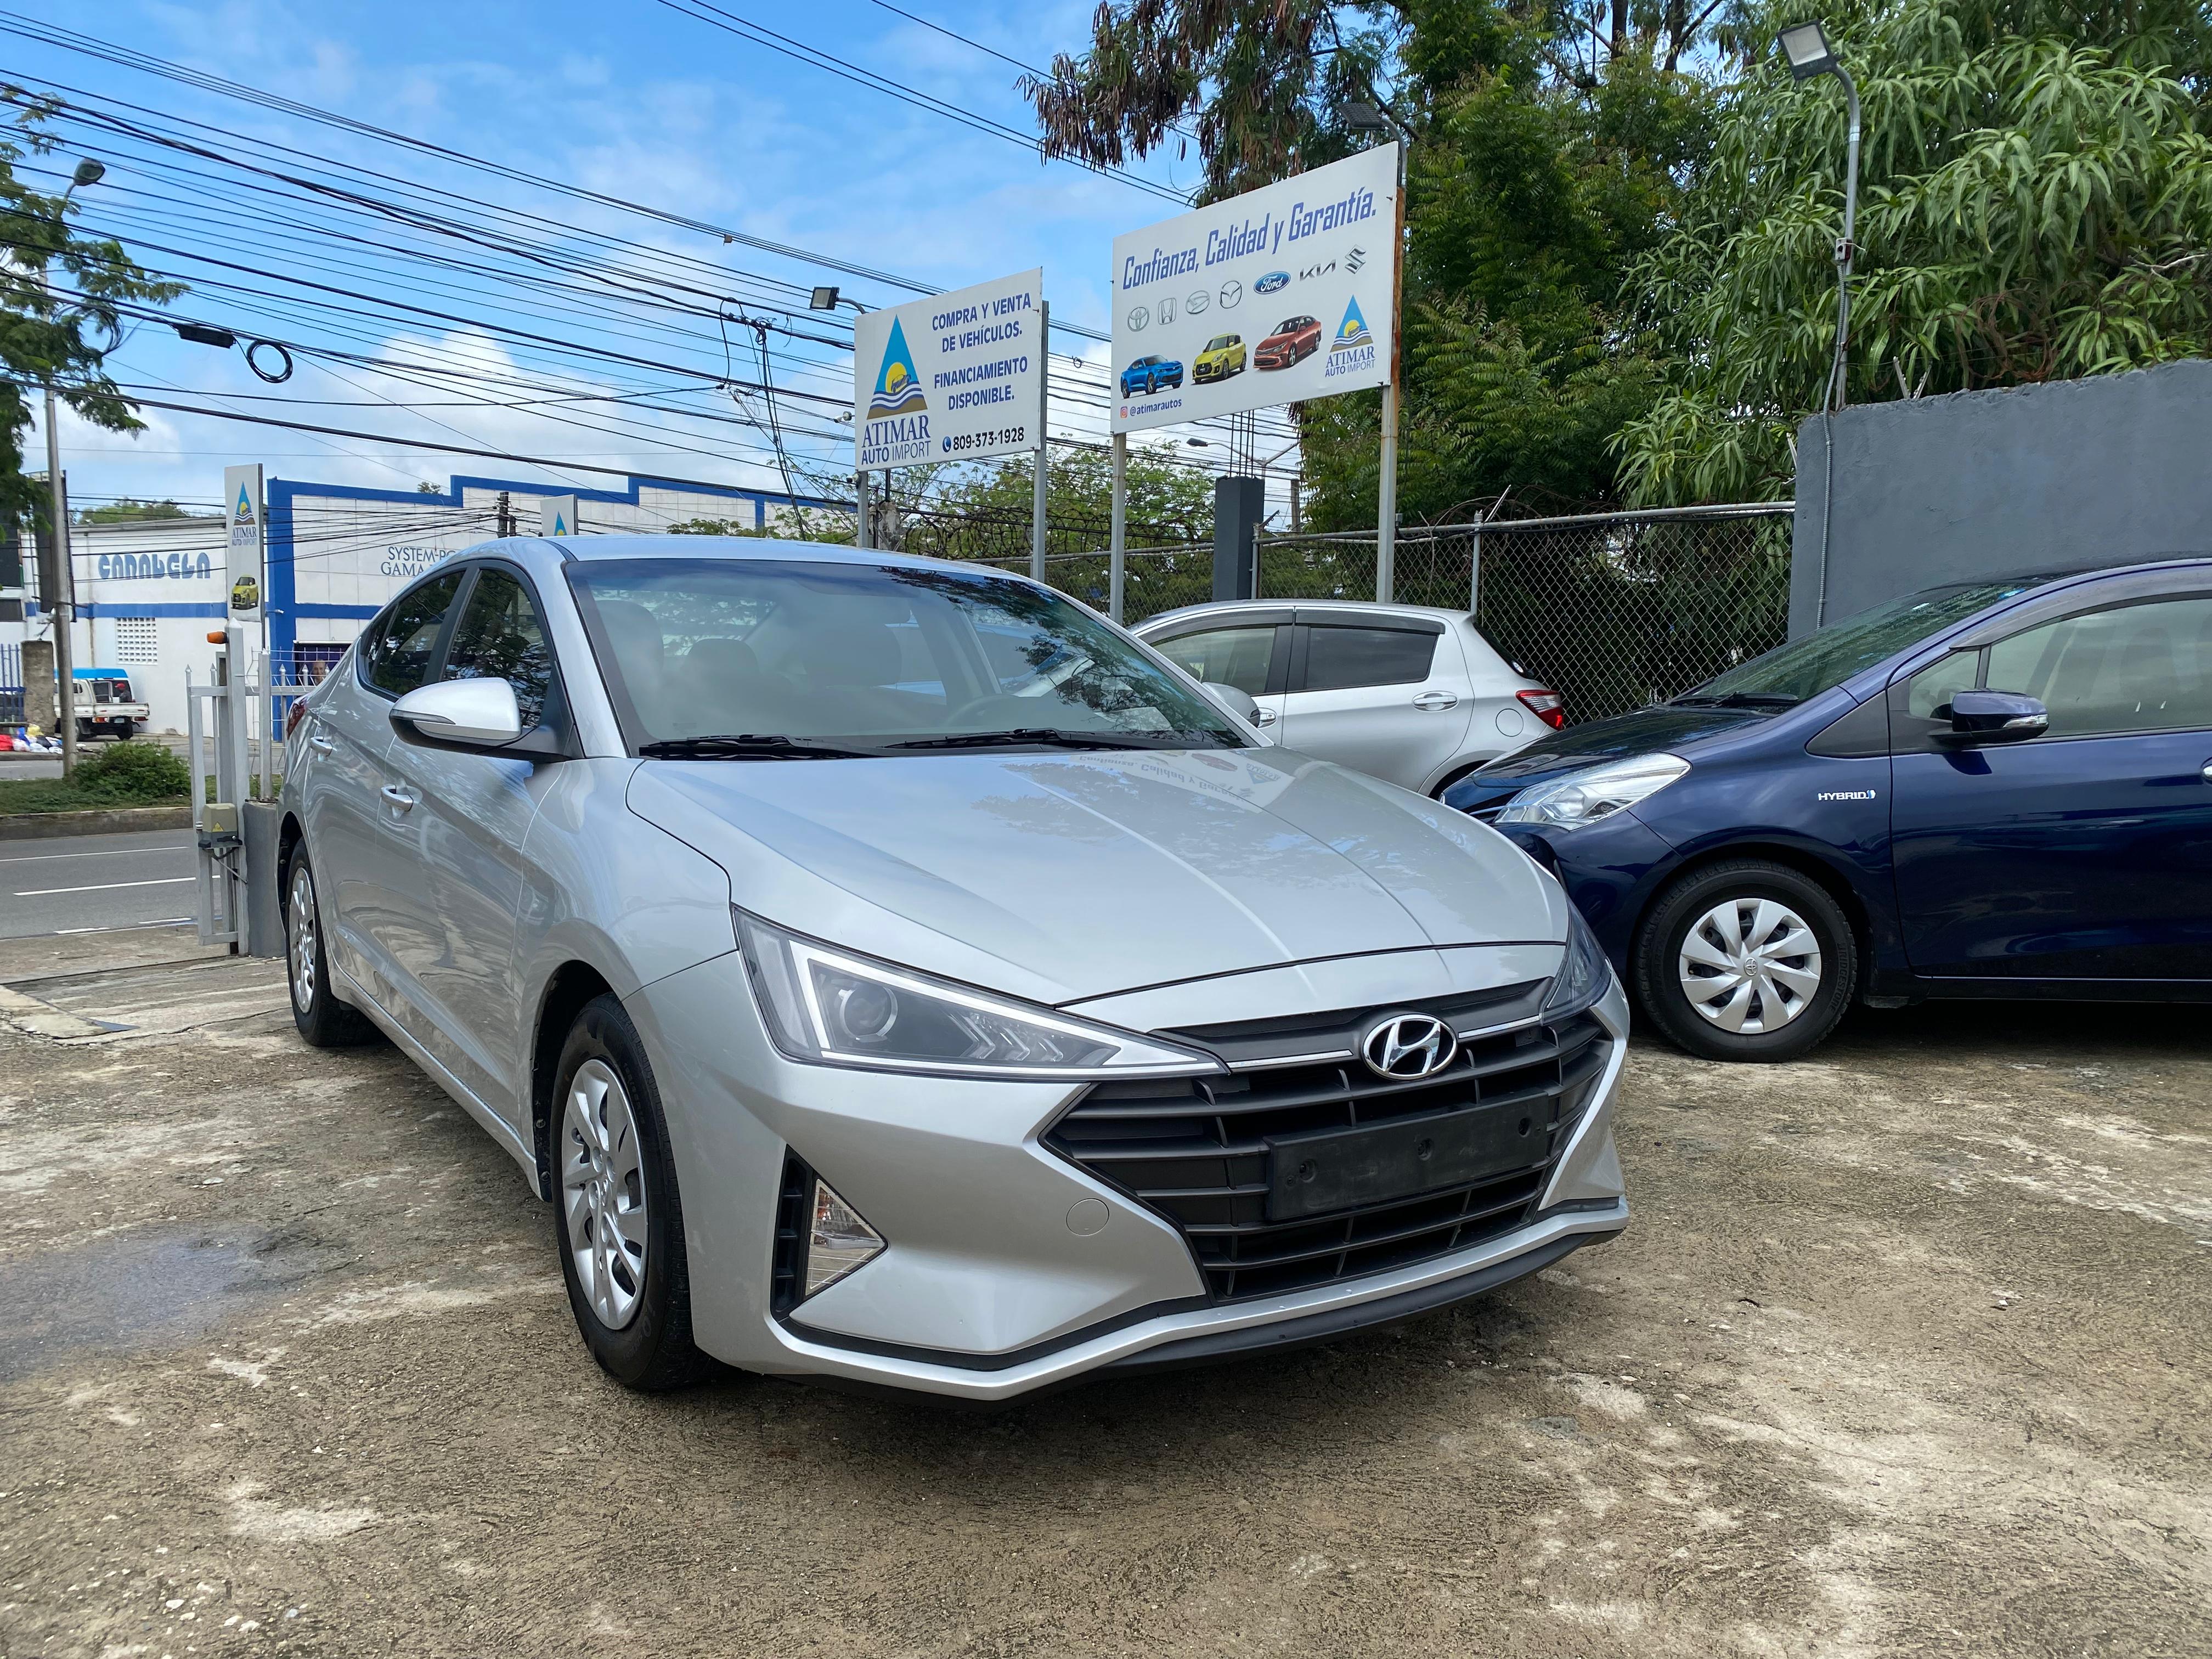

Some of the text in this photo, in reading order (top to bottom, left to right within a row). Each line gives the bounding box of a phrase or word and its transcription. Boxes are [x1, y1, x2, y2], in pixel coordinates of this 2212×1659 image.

[1123, 186, 1377, 290] Confianza, Calidad y Garantía.
[1261, 275, 1283, 291] Ford
[932, 292, 1031, 331] COMPRA Y VENTA
[942, 320, 1023, 353] DE VEHÍCULOS.
[1325, 346, 1375, 368] ATIMAR
[1325, 359, 1375, 377] AUTO IMPORT
[934, 356, 1028, 389] FINANCIAMIENTO
[948, 385, 1014, 410] DISPONIBLE.
[1130, 398, 1182, 416] @atimarautos
[862, 415, 931, 448] ATIMAR
[953, 426, 1025, 451] 809-373-1928
[861, 441, 931, 465] AUTO IMPORT
[232, 526, 257, 538] ATIMAR
[232, 538, 242, 546] AUTO
[1818, 791, 1866, 801] HYBRID
